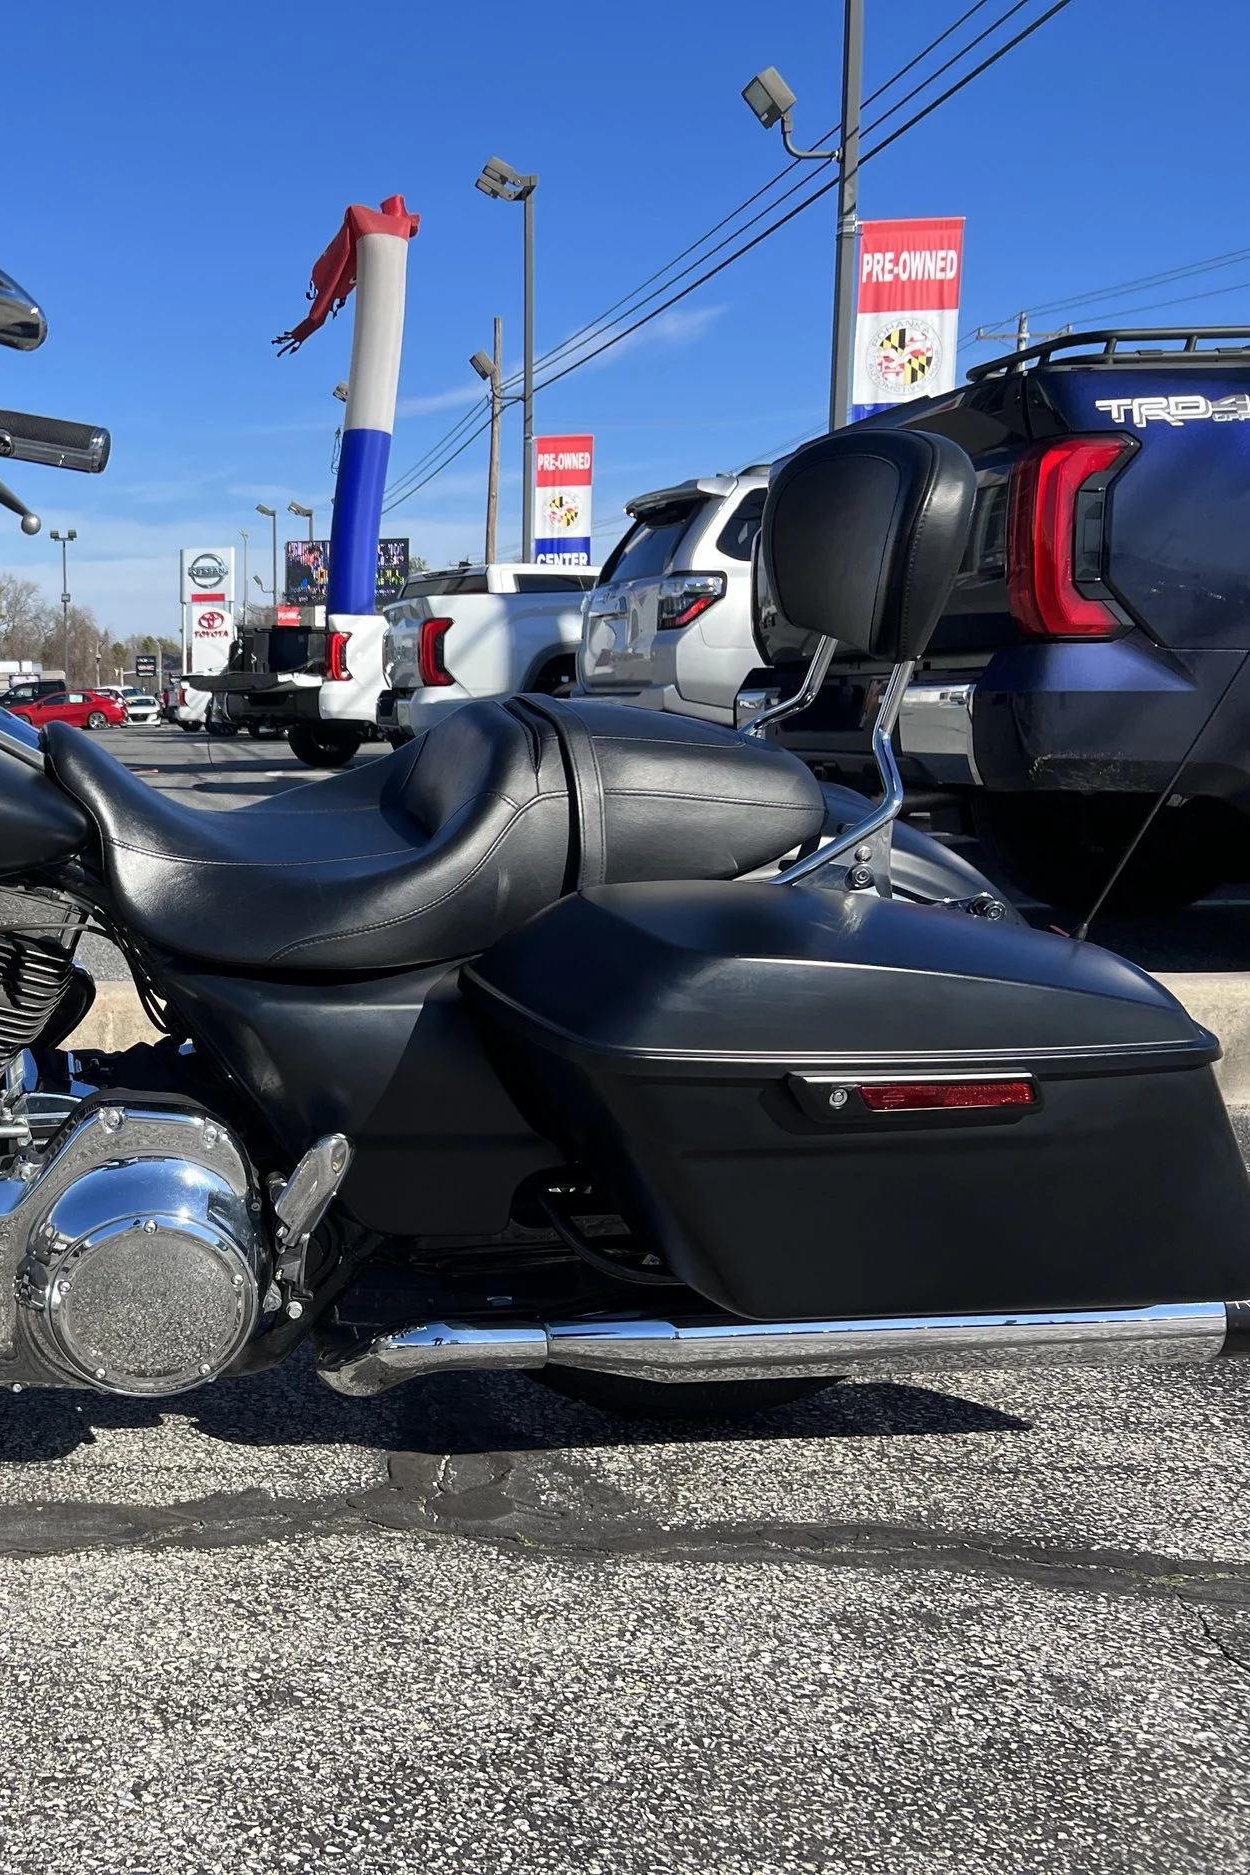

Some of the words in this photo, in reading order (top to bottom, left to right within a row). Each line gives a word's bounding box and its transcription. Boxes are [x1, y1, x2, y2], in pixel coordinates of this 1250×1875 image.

[862, 250, 958, 283] PRE-OWNED
[871, 320, 930, 347] POHANKA
[1095, 395, 1213, 428] TRD
[537, 452, 591, 471] PRE-OWNED
[191, 566, 226, 577] NISSAN
[194, 630, 229, 639] TOYOTA
